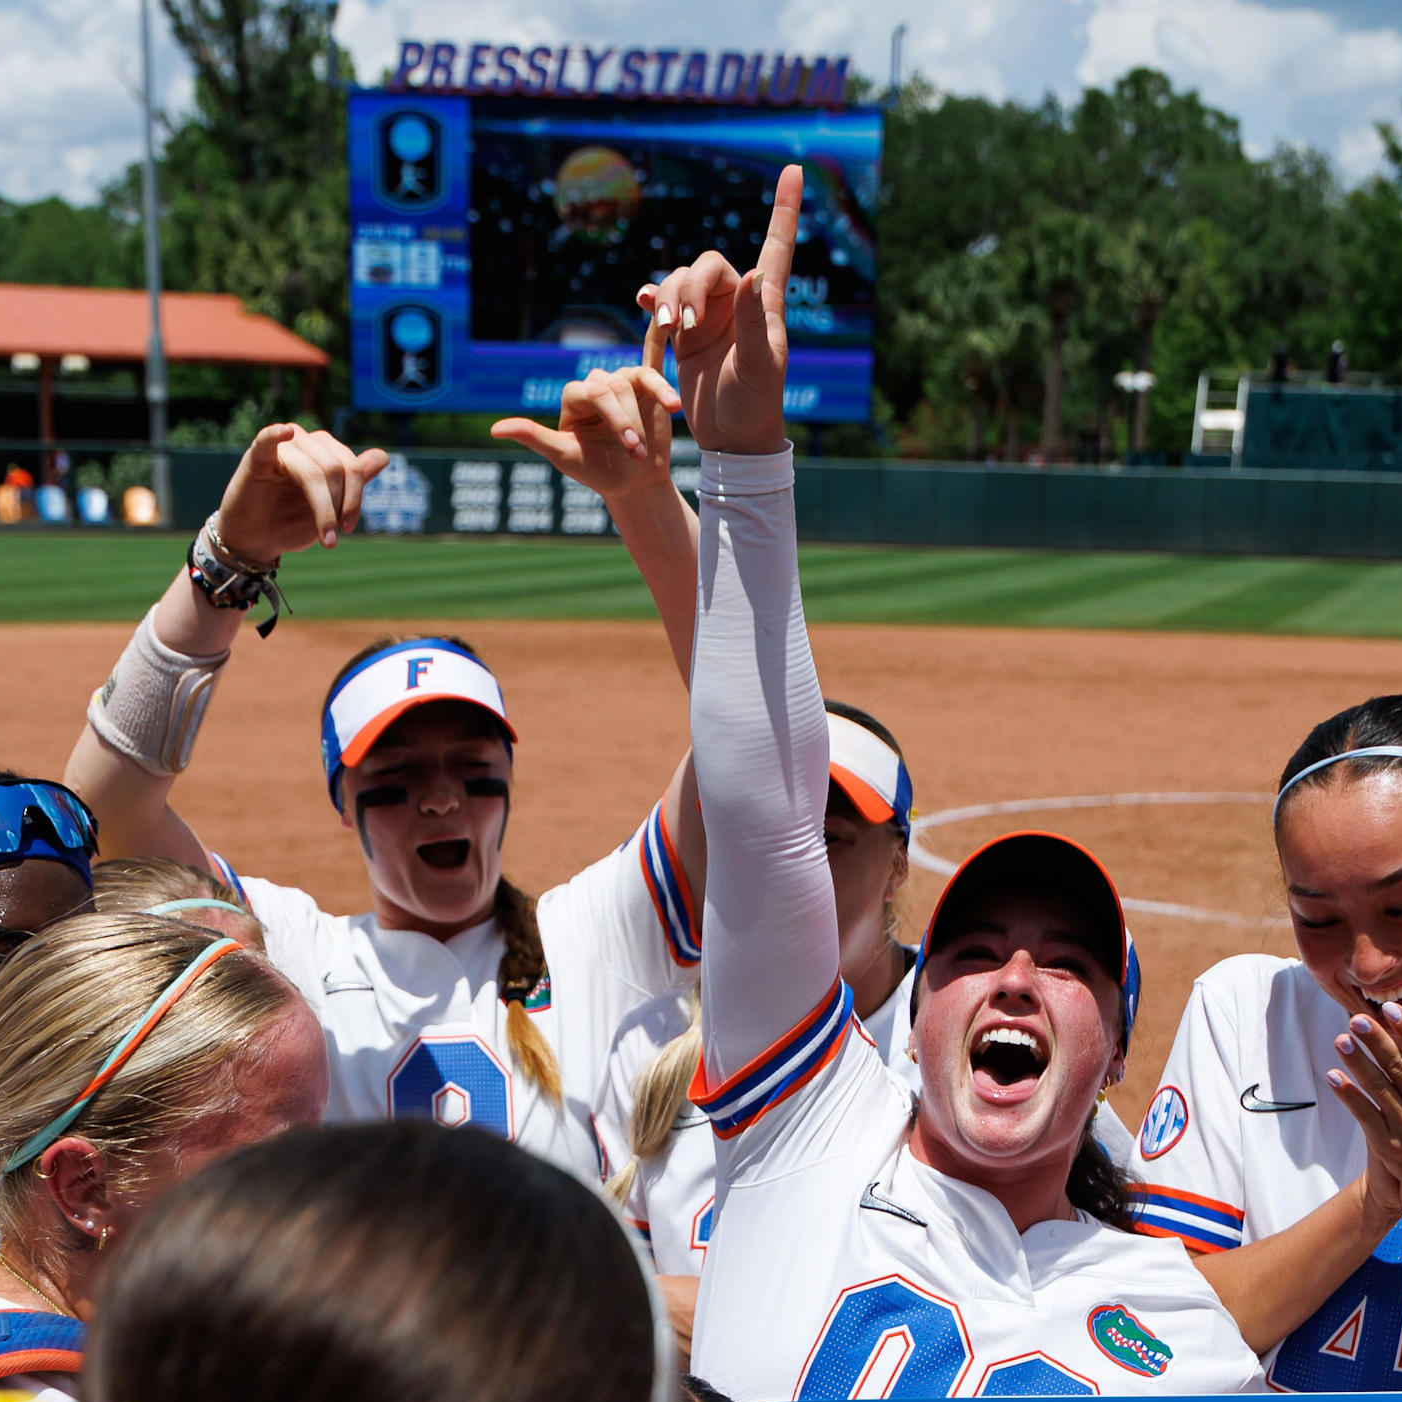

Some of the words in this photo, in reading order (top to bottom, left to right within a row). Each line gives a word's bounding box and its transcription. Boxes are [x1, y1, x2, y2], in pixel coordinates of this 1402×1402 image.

[394, 41, 612, 94] PRESSLY
[615, 49, 852, 108] STADIUM
[404, 657, 434, 691] F
[1142, 1089, 1185, 1154] SEC
